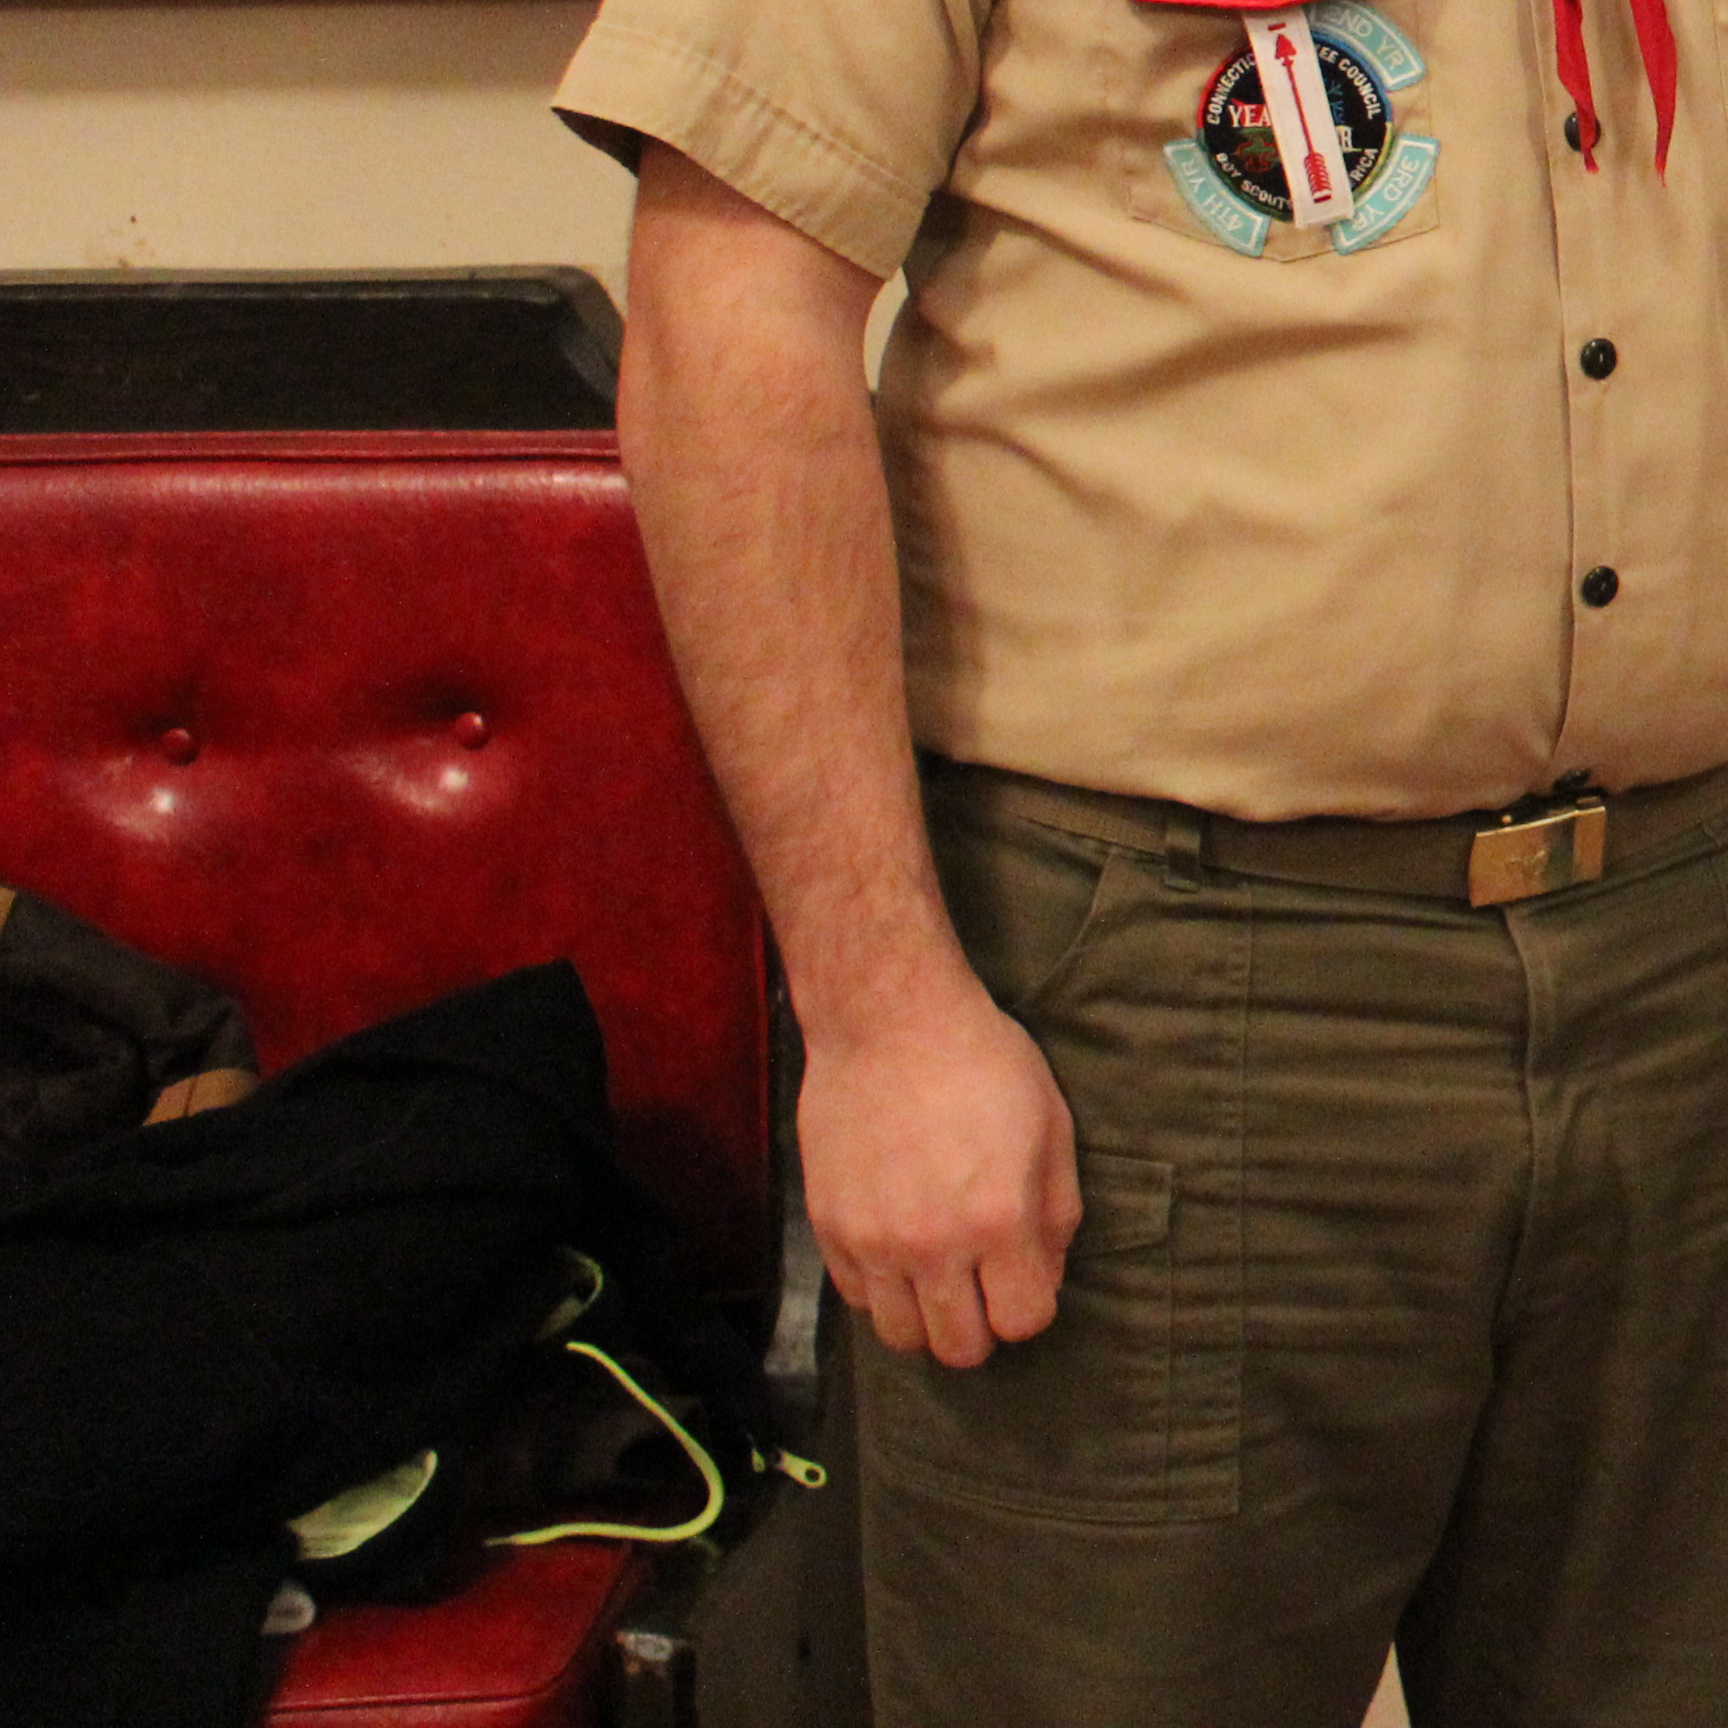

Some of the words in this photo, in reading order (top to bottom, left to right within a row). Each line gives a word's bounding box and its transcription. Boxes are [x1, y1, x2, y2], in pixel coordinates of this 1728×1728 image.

[1206, 51, 1257, 126] CONNECTIC
[1337, 57, 1383, 121] COUNCIL
[1227, 104, 1272, 128] YEA
